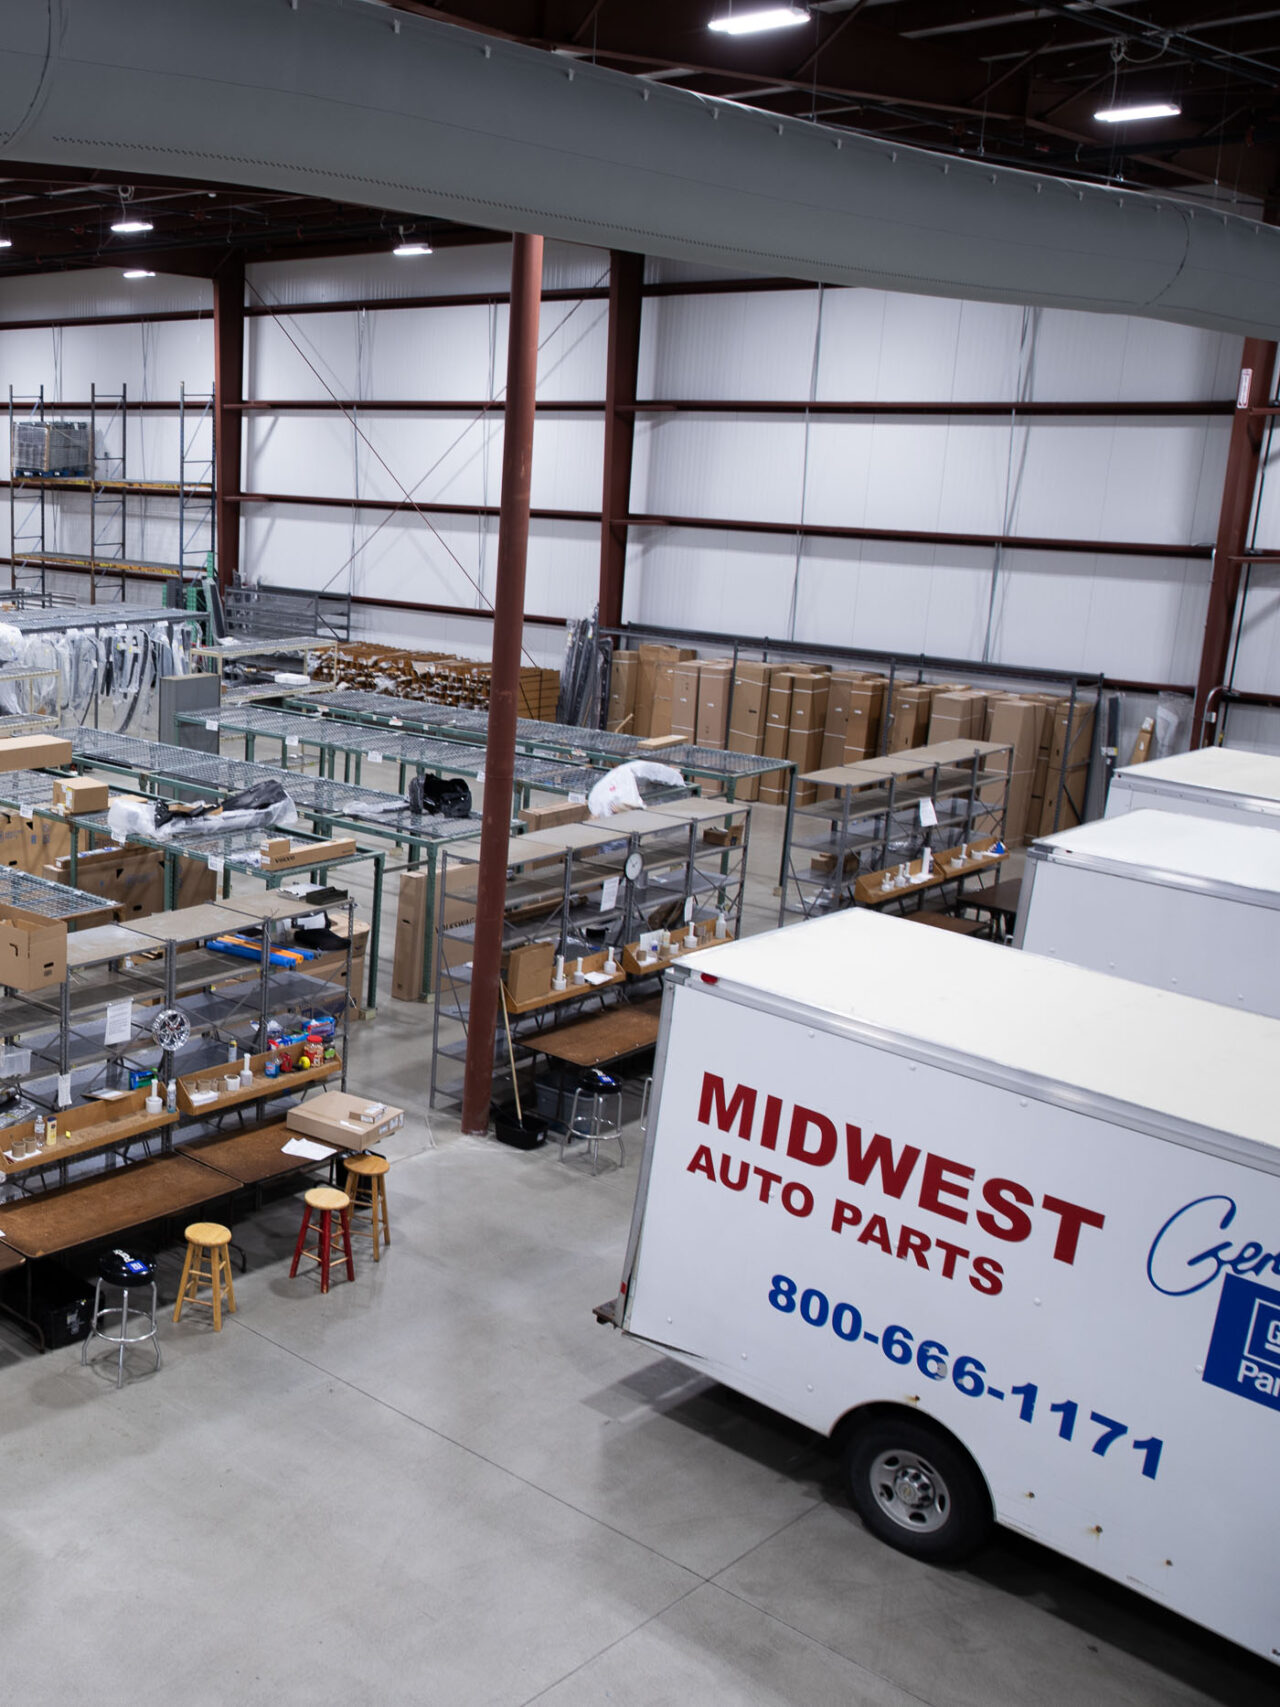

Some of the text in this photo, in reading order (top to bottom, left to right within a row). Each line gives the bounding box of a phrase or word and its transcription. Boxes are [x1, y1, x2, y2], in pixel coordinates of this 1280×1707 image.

[686, 1144, 1004, 1296] AUTO PARTS
[698, 1072, 1105, 1265] MIDWEST
[767, 1274, 1164, 1481] 800-666-1171
